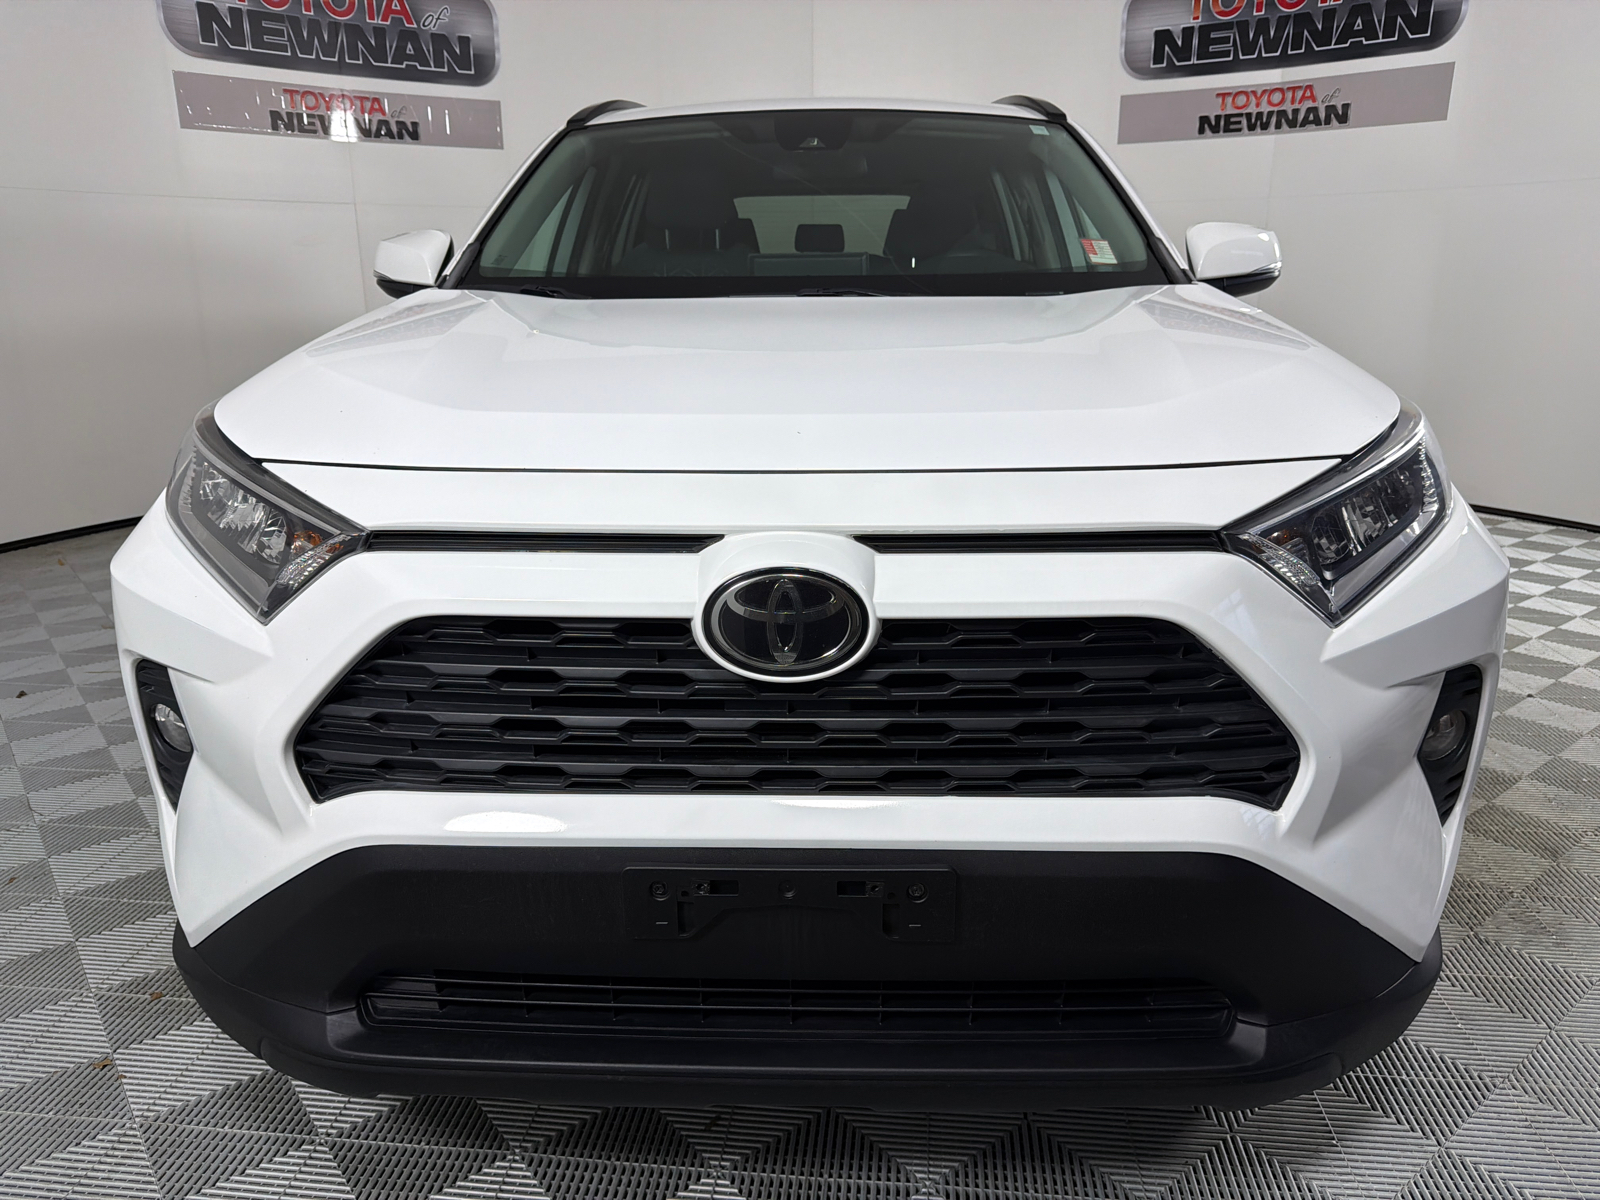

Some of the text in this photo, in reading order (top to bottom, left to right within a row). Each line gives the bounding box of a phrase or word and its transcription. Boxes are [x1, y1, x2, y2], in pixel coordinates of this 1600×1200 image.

[422, 8, 449, 30] of
[1151, 0, 1434, 66] NEWNAN
[196, 2, 474, 74] NEWNAN
[283, 88, 386, 117] TOYOTA
[1216, 84, 1341, 111] TOYOTA of
[1198, 103, 1351, 136] NEWNAN
